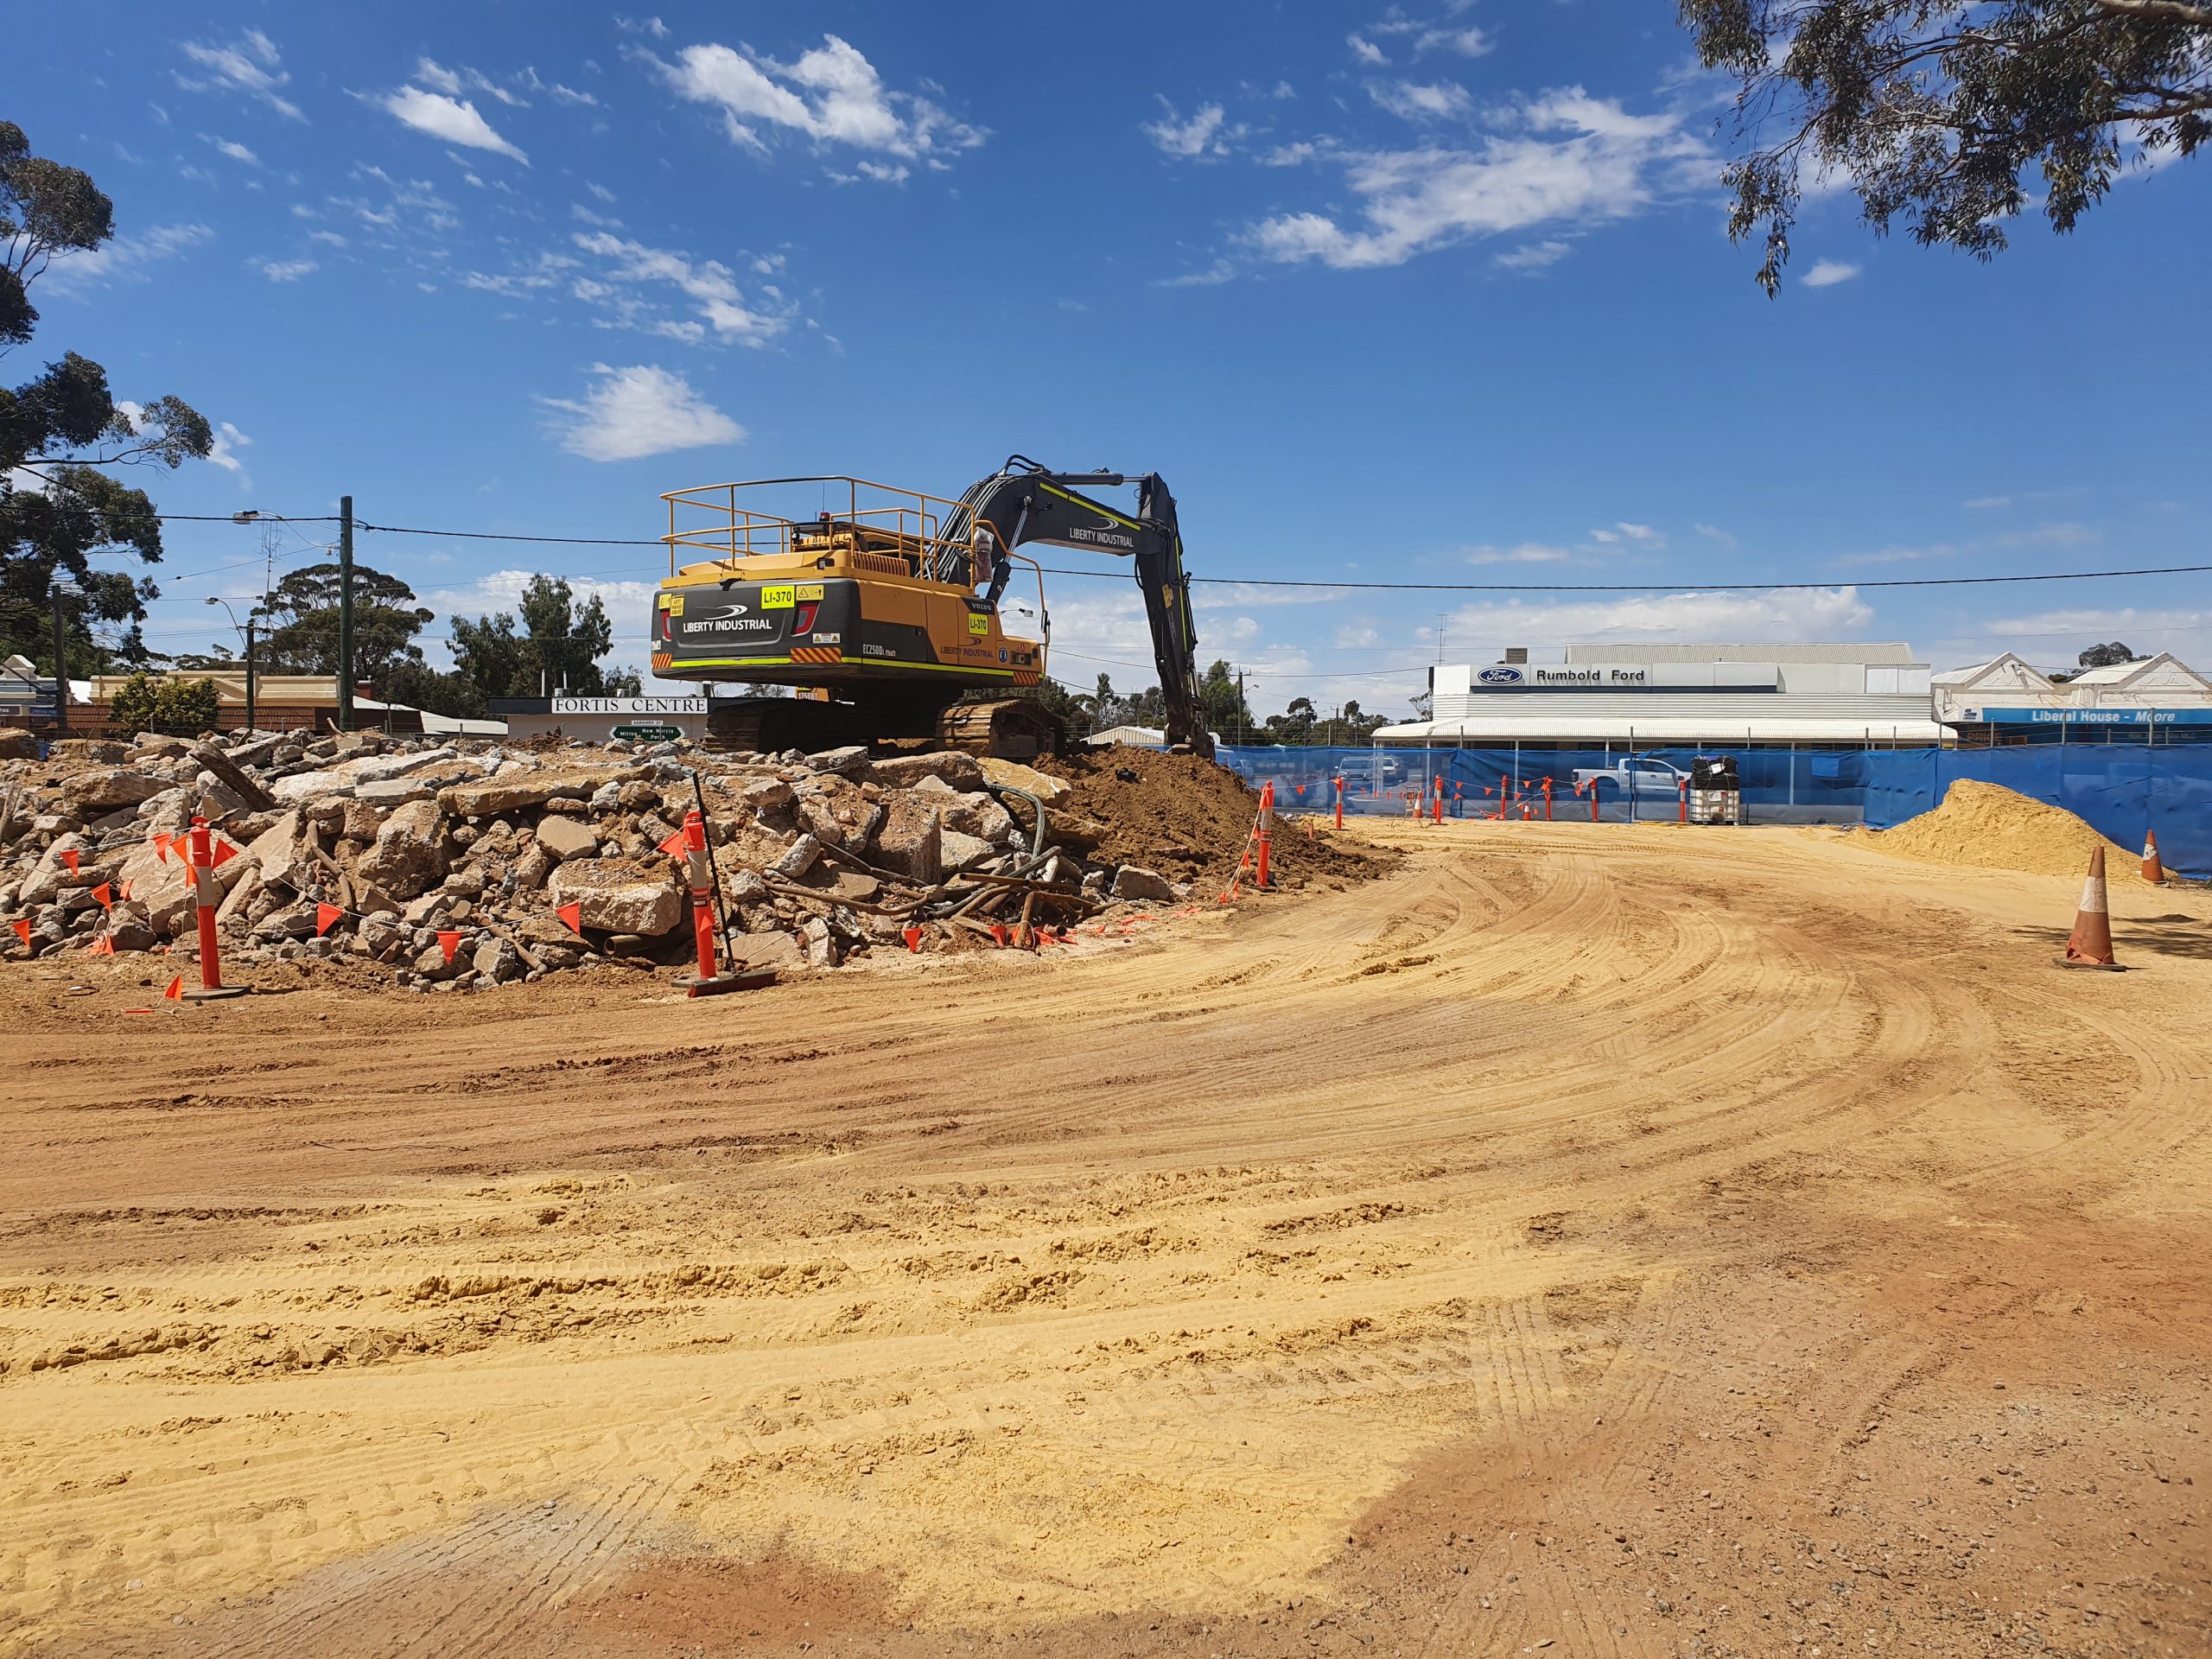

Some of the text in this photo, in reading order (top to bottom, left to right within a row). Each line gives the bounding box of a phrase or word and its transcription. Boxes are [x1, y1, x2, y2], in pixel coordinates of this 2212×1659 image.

[1070, 527, 1134, 548] LIBERTY INDUSTRIAL
[764, 591, 791, 603] LI-370
[972, 602, 992, 611] VOLVO
[683, 619, 772, 633] LIBERTY INDUSTRIAL
[969, 618, 987, 630] LI-370
[940, 645, 994, 658] LIBERTY INDUSTRIAL
[1486, 670, 1513, 681] Ford
[1536, 670, 1644, 681] Rumbold Ford
[556, 699, 706, 712] FORTIS CENTRE
[2032, 710, 2076, 721] Liberal
[2081, 710, 2120, 722] House
